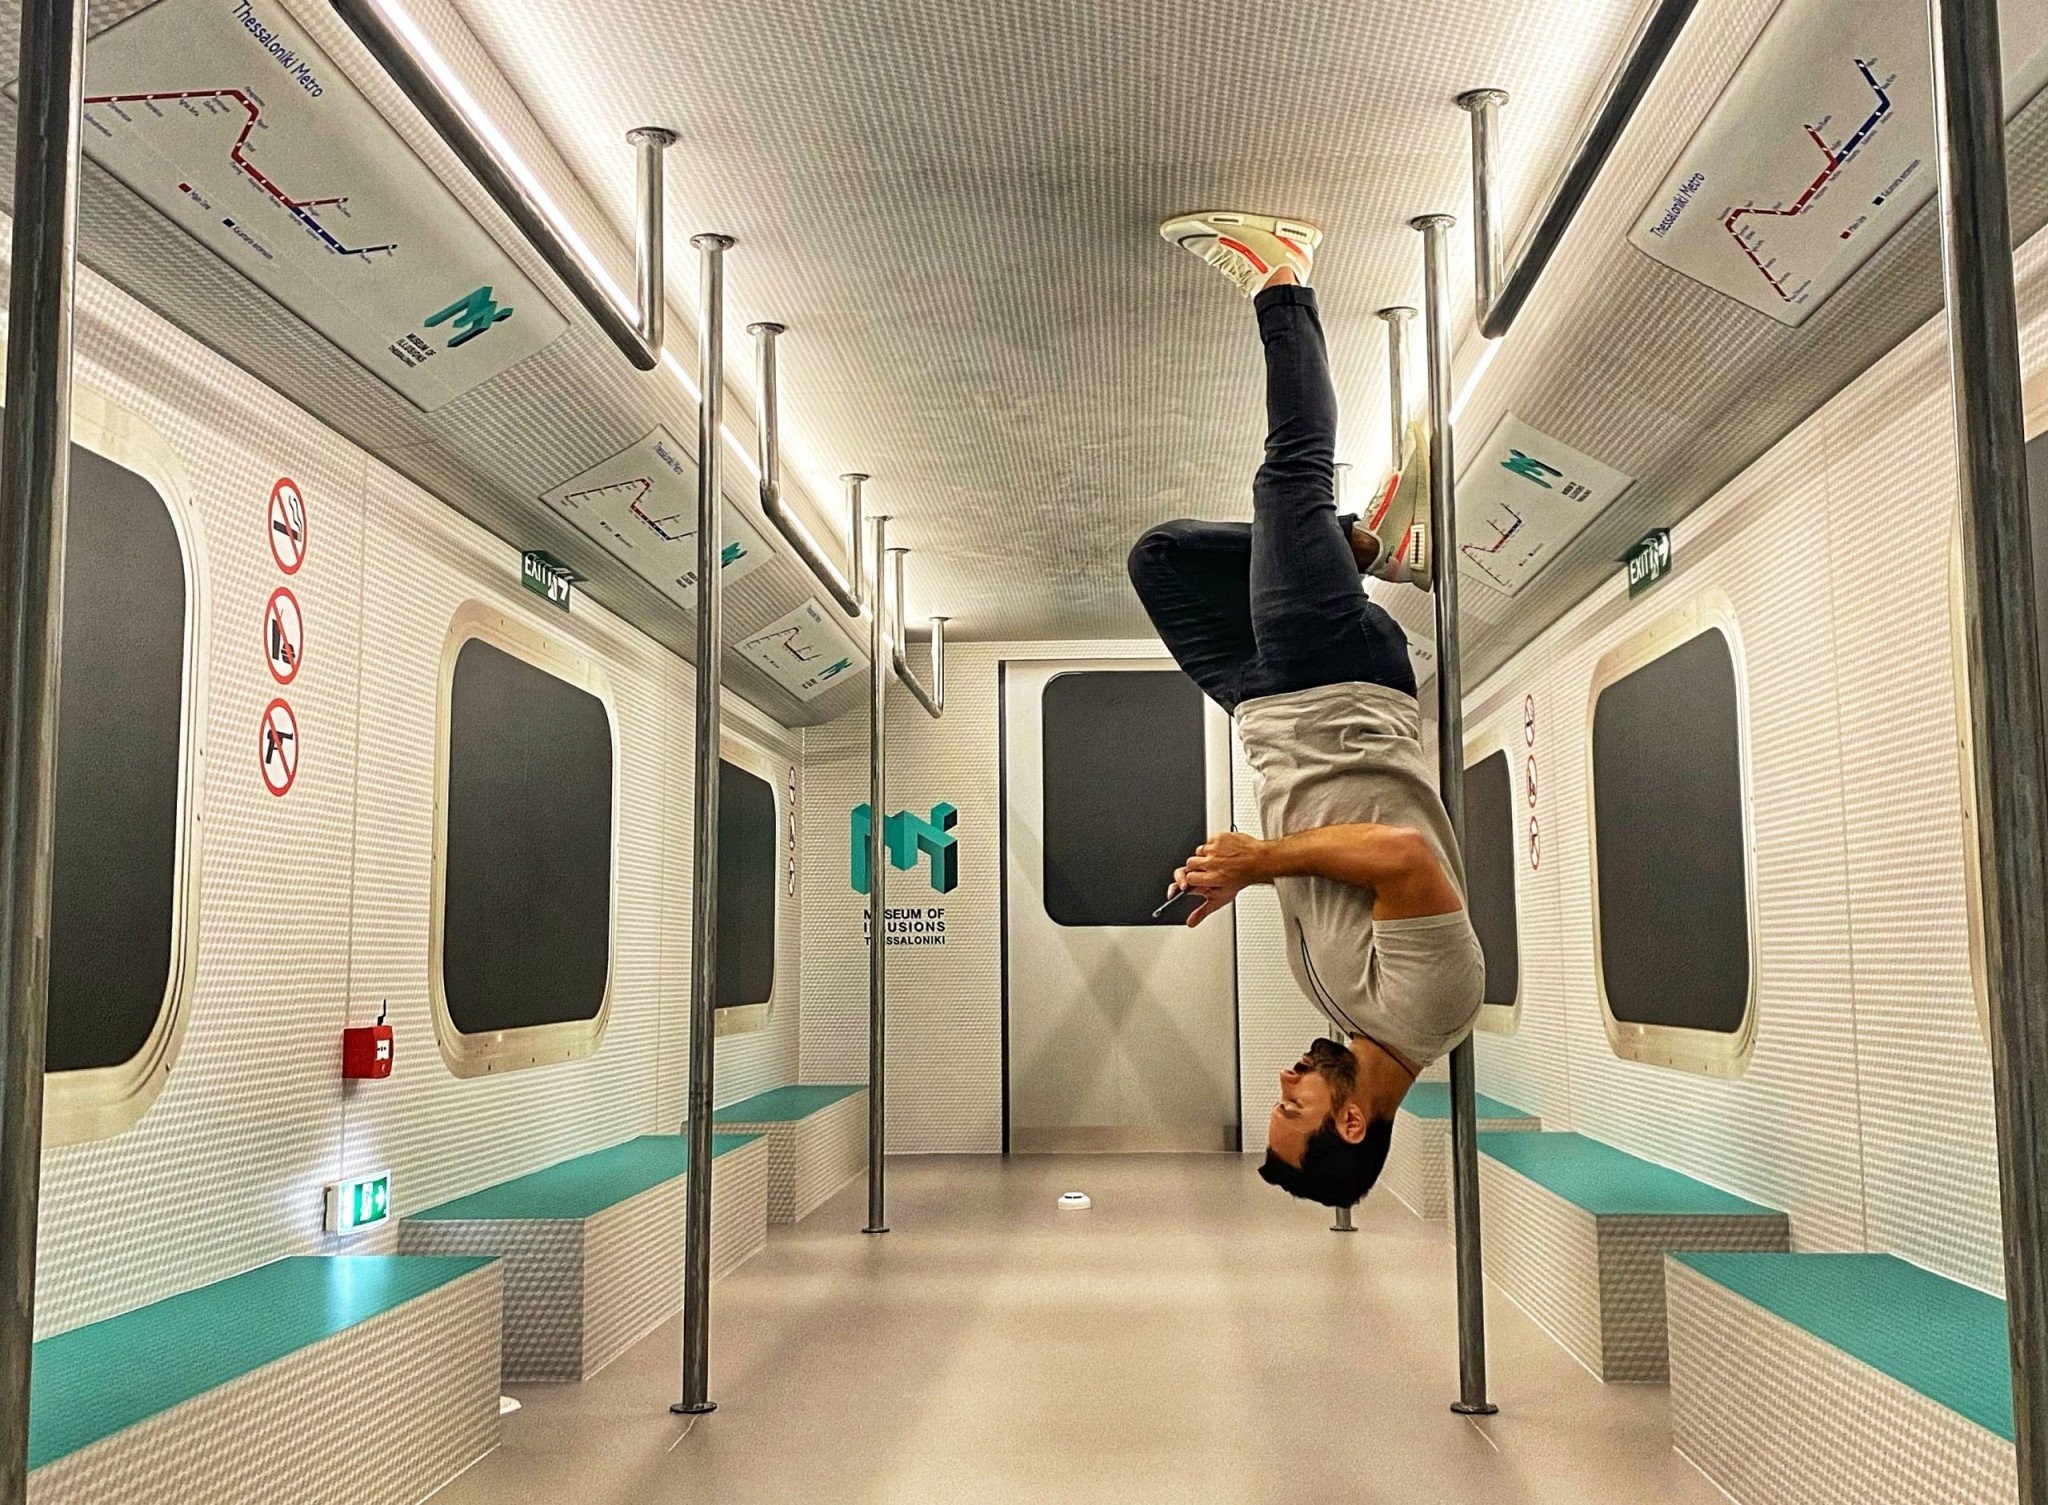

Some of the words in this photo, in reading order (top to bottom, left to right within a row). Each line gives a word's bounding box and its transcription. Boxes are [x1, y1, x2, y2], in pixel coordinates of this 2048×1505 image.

[232, 0, 299, 69] Thessaloniki
[290, 62, 323, 97] Metro
[1649, 193, 1689, 238] Thessaloniki
[1679, 172, 1705, 198] Metro
[864, 909, 921, 919] MSEUM
[927, 908, 945, 919] OF
[864, 921, 946, 932] IUSIONS
[864, 936, 945, 945] TSSALONIKI
